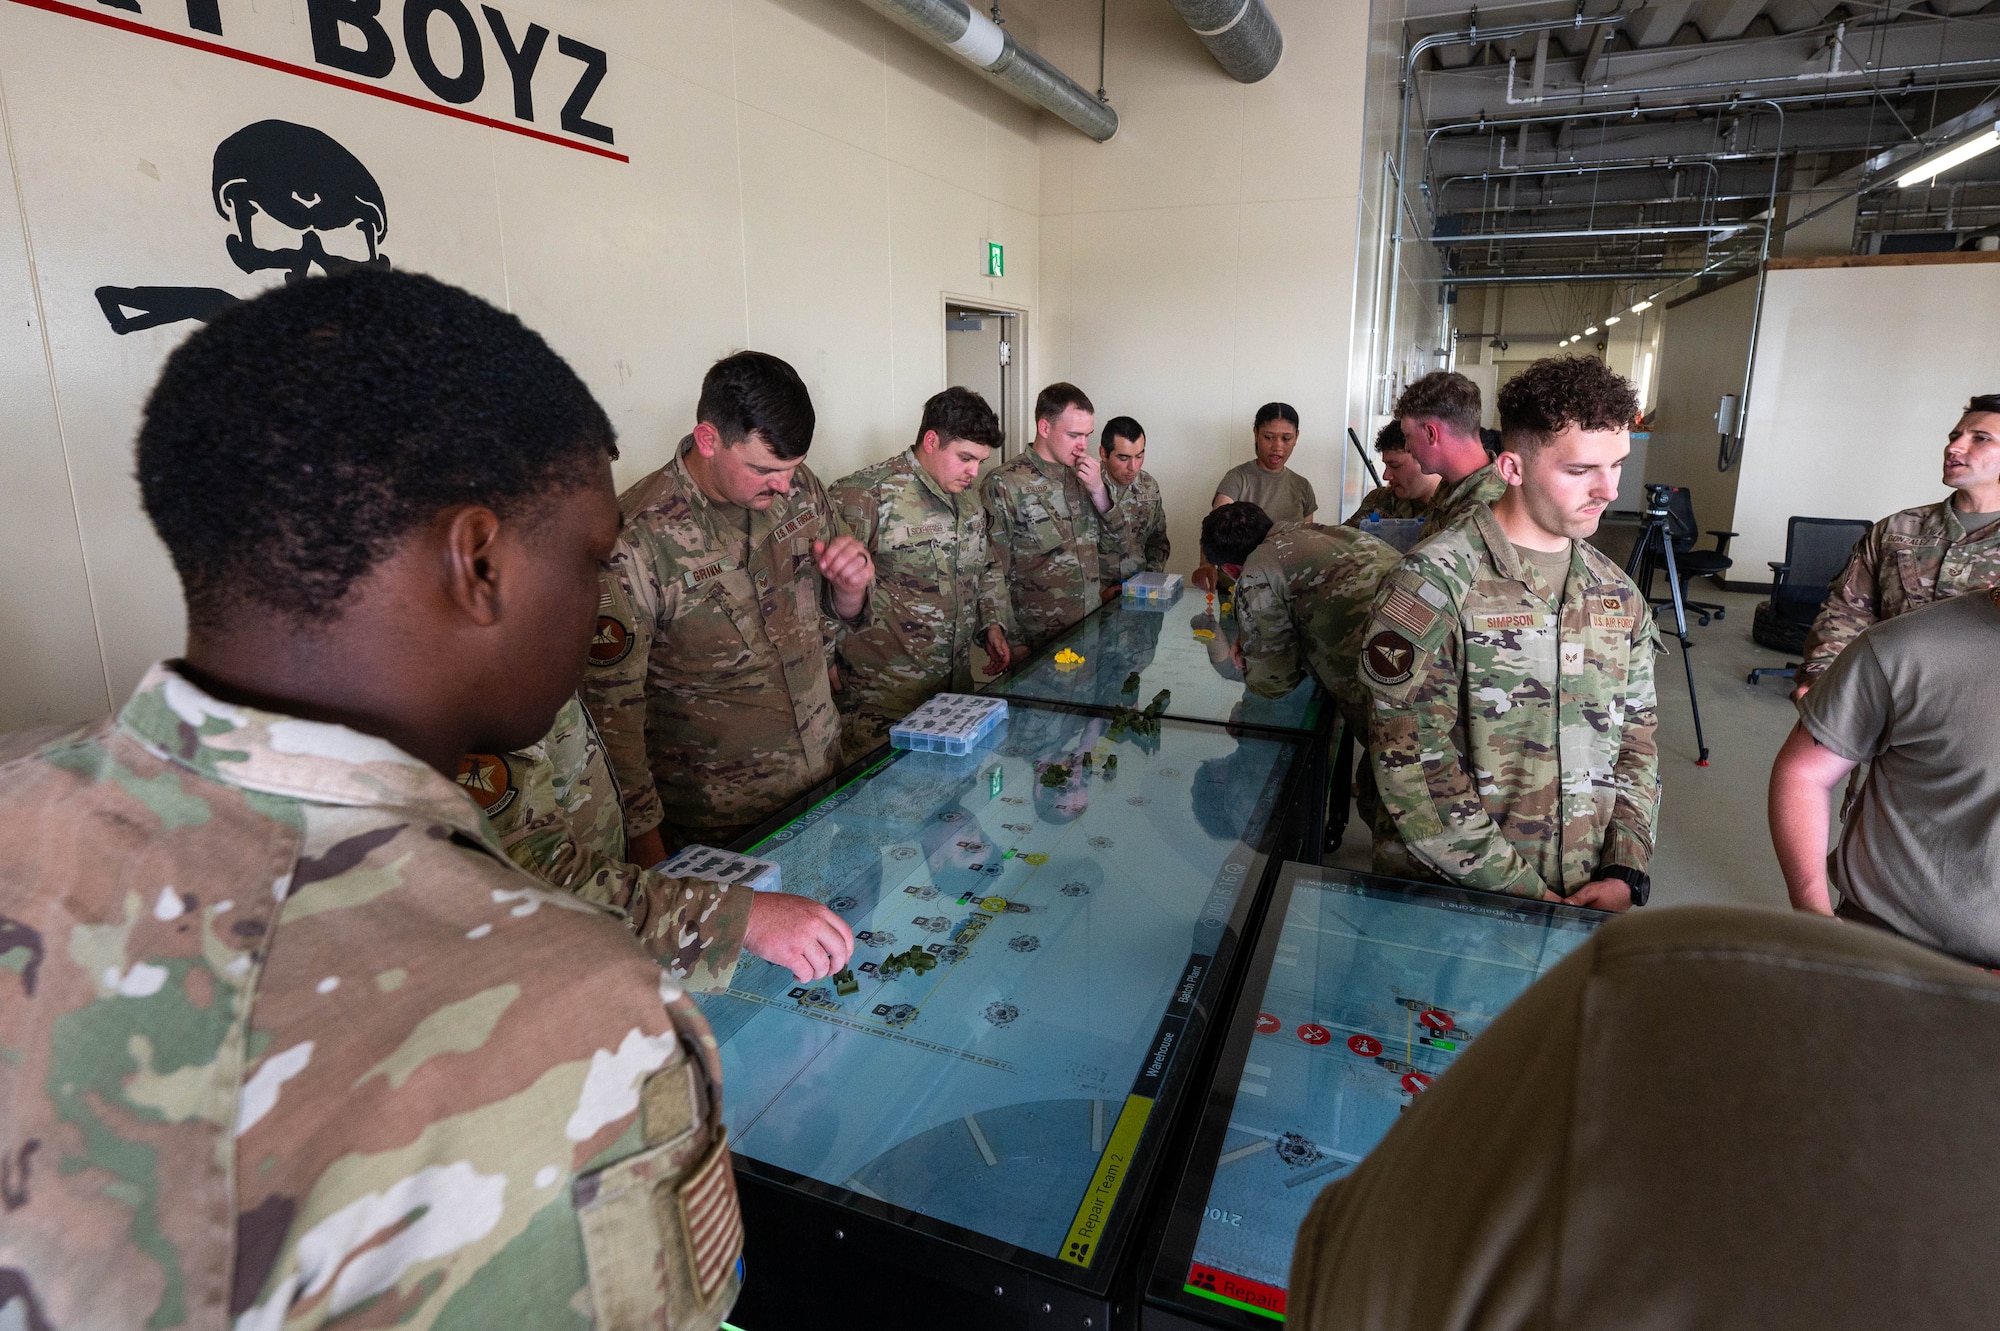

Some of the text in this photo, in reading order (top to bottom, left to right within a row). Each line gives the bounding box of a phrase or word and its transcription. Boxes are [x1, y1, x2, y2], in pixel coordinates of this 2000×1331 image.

[309, 0, 614, 145] BOYZ
[785, 522, 799, 535] AIR
[797, 509, 815, 529] FORCE
[1887, 534, 1930, 546] GONZALEZ
[692, 563, 723, 582] GRIMM
[1487, 614, 1535, 629] SIMPSON
[1593, 615, 1605, 628] U.S.
[1606, 616, 1617, 629] AIR
[1206, 875, 1239, 916] 00:15:16
[1445, 902, 1477, 912] Zone
[1478, 906, 1514, 919] Repair
[1177, 964, 1203, 1005] Batch Plant
[1145, 1031, 1175, 1079] Warehouse
[1078, 1152, 1124, 1239] Repair Team 2
[1223, 1280, 1280, 1310] Repair
